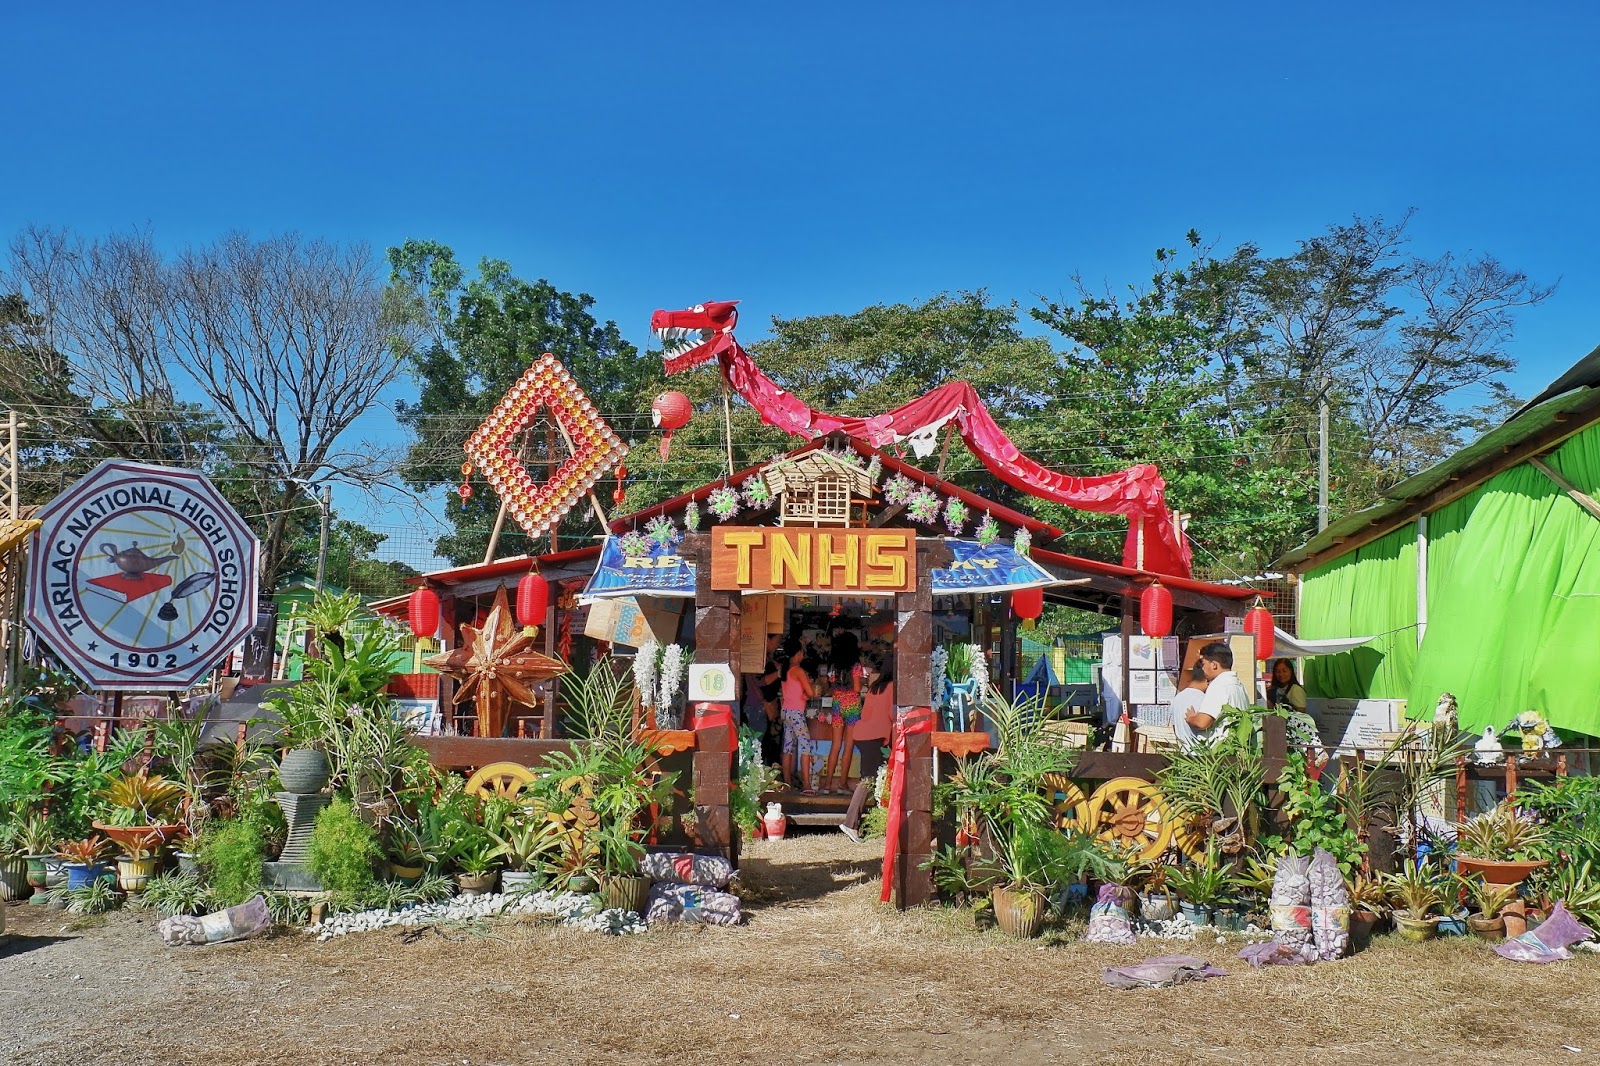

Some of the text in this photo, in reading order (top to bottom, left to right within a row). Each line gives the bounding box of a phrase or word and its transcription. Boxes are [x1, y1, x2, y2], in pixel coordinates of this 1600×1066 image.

[51, 486, 238, 637] TARLAC NATIONAL HIGH SCHOOL
[724, 531, 906, 588] TNHS
[110, 653, 177, 668] 1902
[703, 674, 724, 691] 18
